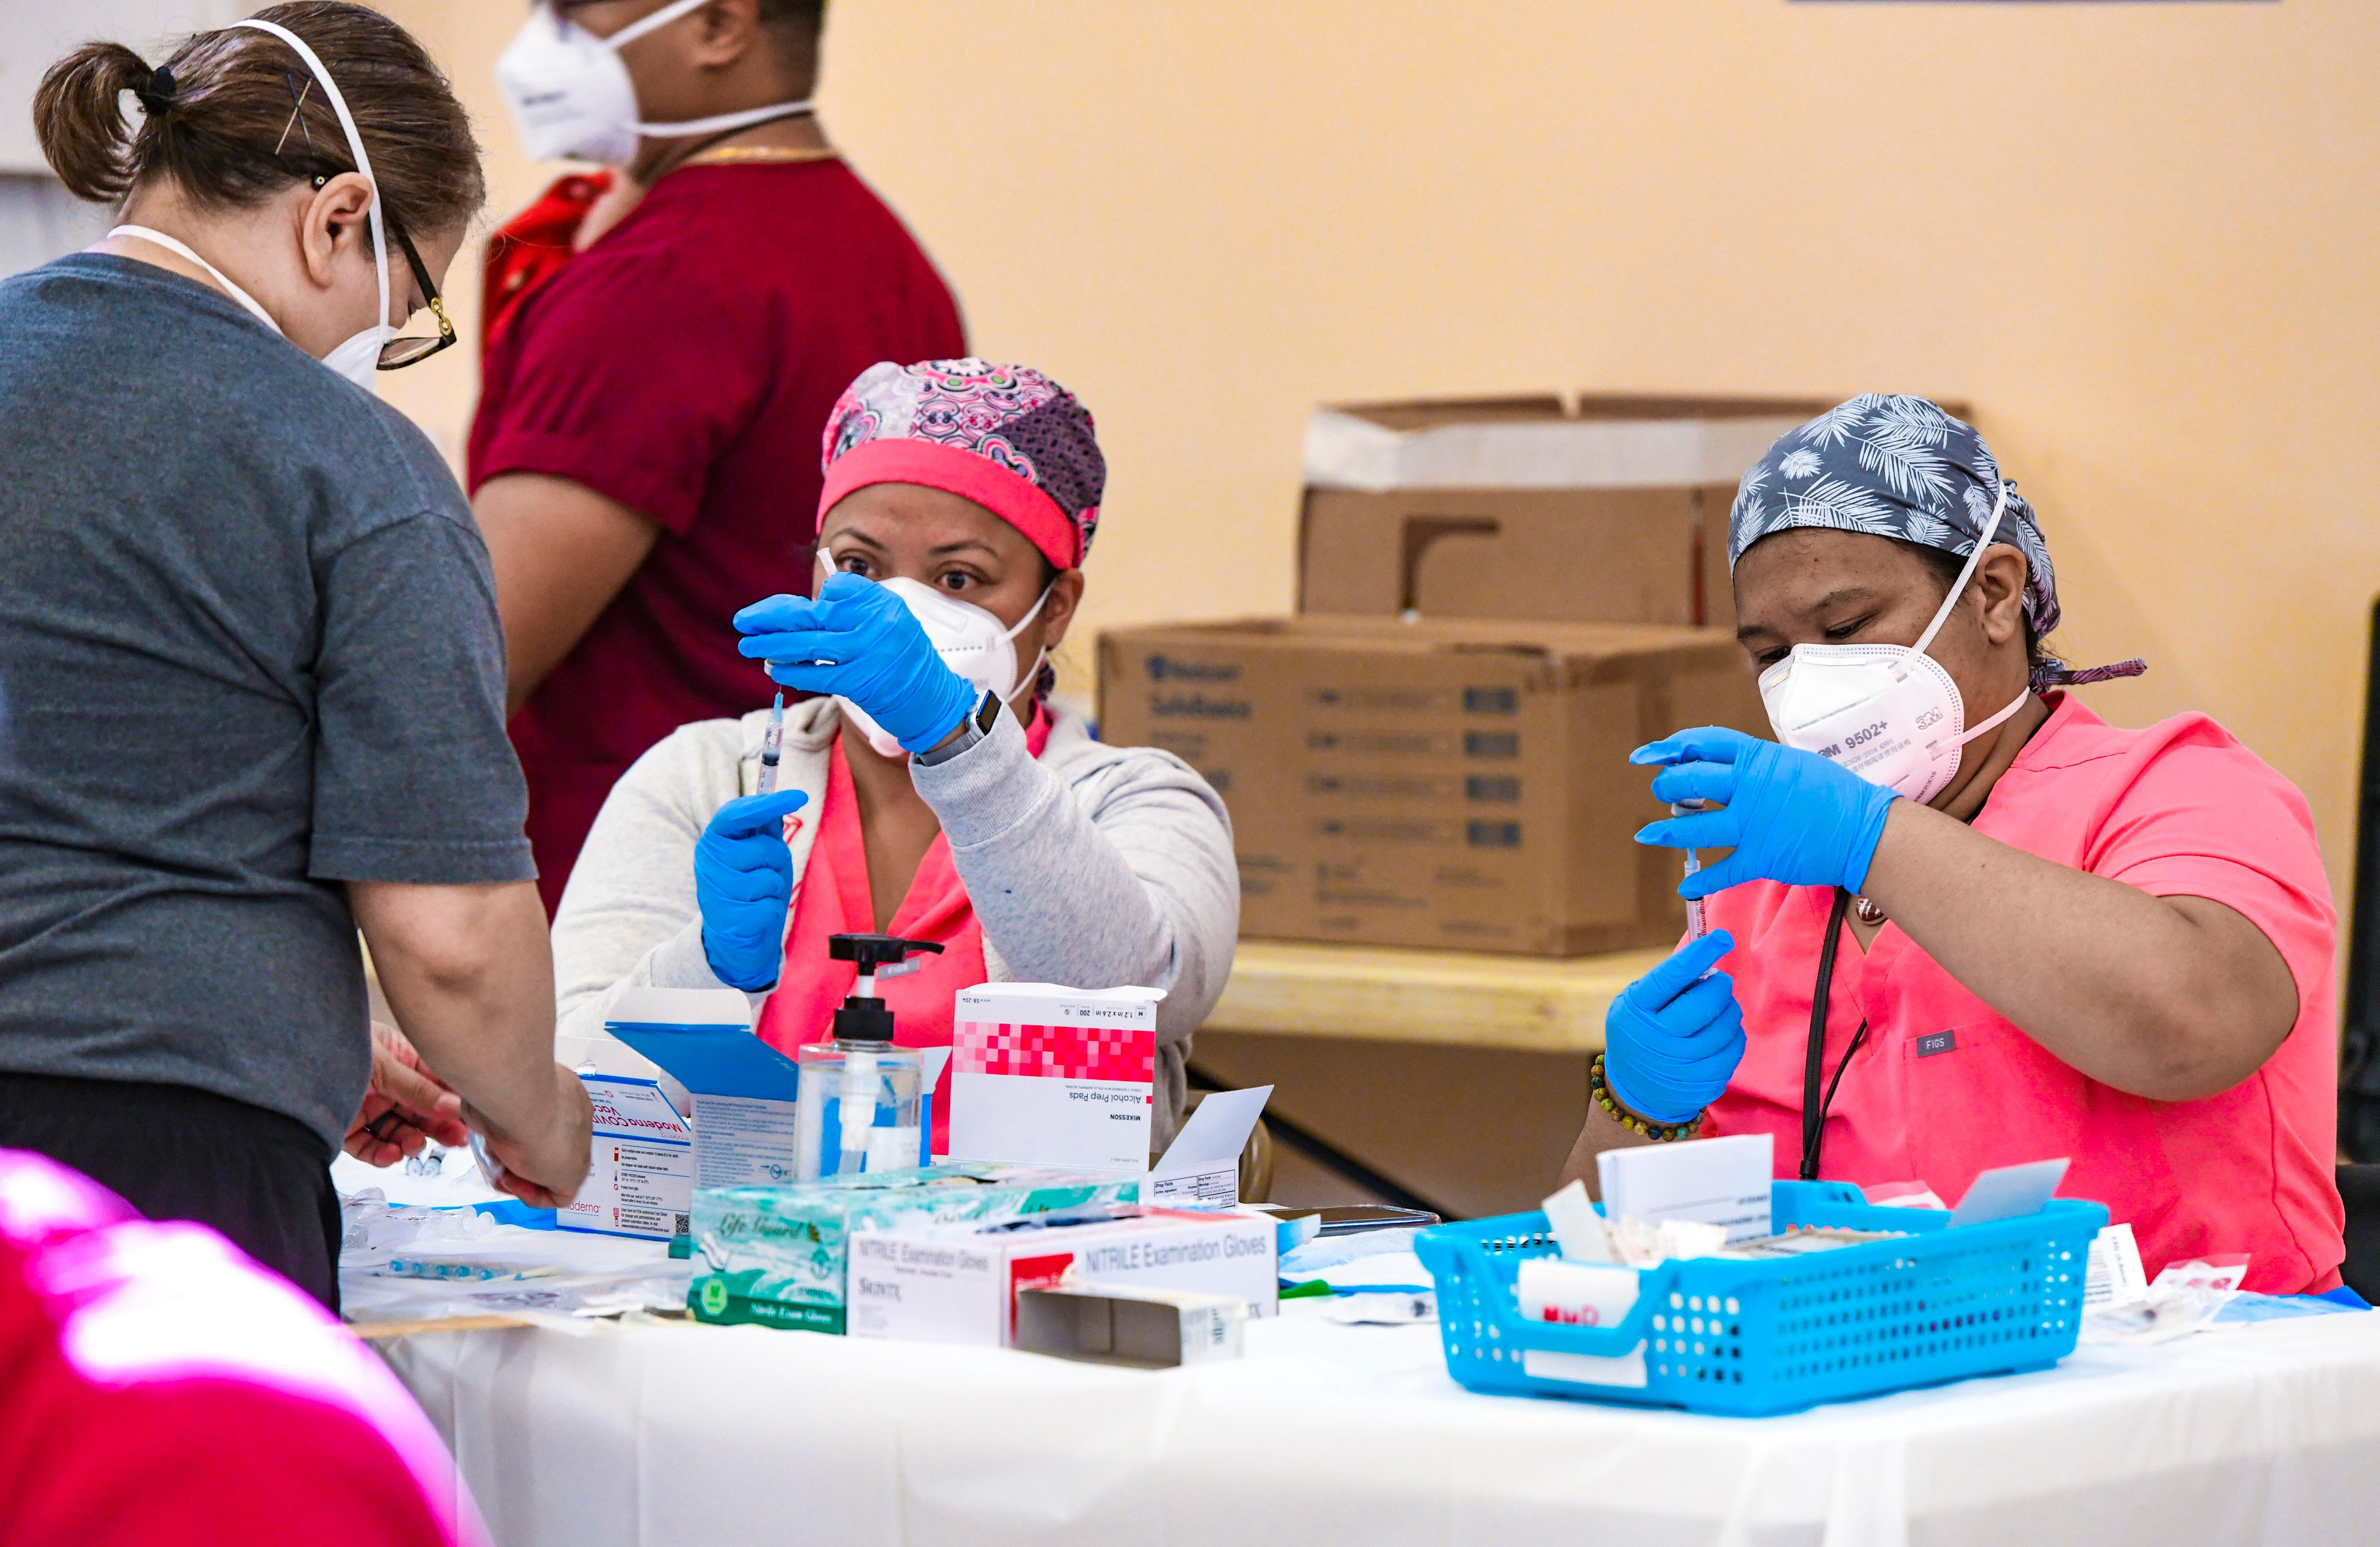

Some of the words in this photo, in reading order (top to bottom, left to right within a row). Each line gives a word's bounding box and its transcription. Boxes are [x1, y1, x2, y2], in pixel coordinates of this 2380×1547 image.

[1916, 707, 1943, 730] 3M
[1845, 721, 1888, 749] 9502+
[1841, 747, 1878, 768] B2626-2019
[1880, 738, 1894, 750] KN95
[1849, 738, 1911, 773] 请仔细阅读使用说明
[1926, 1038, 1945, 1049] FIGS
[1069, 1092, 1088, 1101] Pads
[1091, 1092, 1109, 1102] Prep
[1111, 1094, 1141, 1104] Alcohol
[627, 1118, 683, 1133] Moderna
[1085, 1245, 1139, 1273] NITRILE
[1144, 1238, 1220, 1268] Examination
[1224, 1234, 1266, 1259] Gloves
